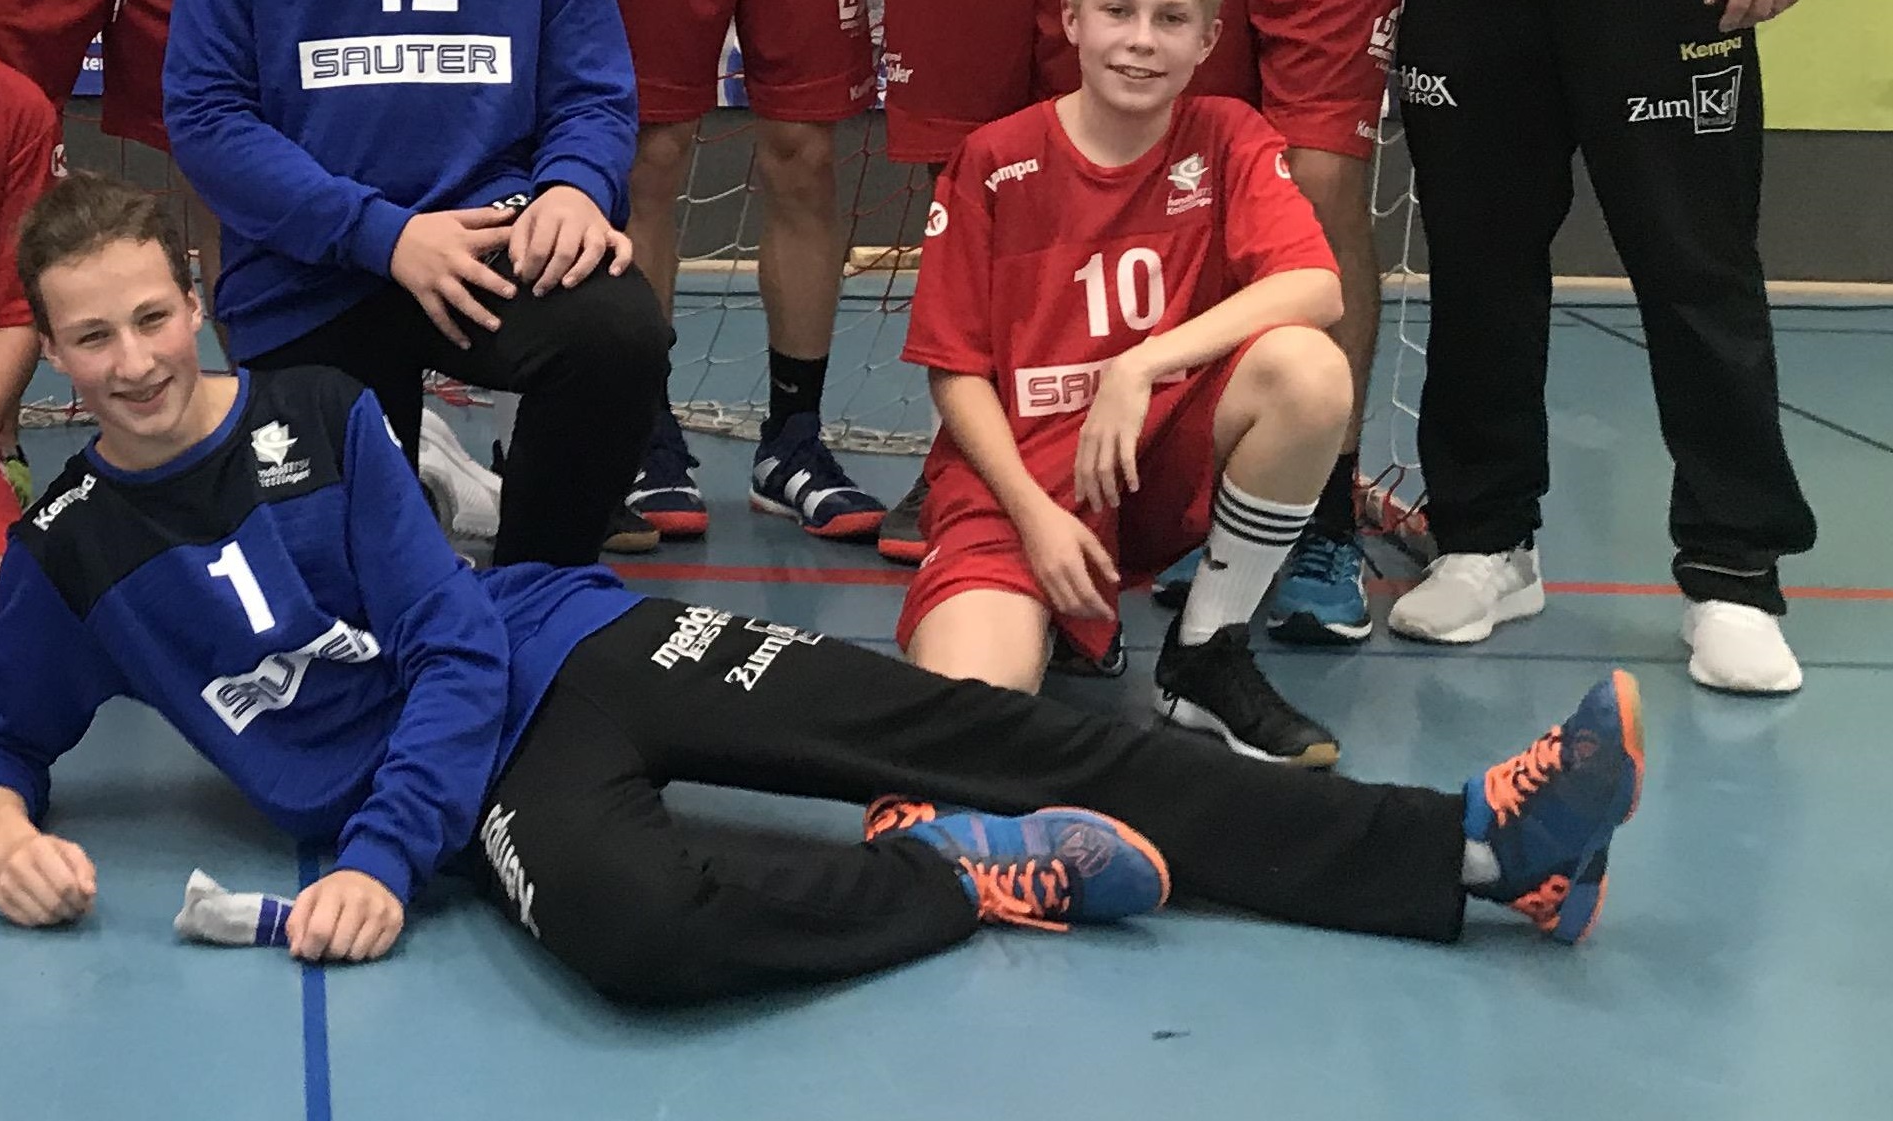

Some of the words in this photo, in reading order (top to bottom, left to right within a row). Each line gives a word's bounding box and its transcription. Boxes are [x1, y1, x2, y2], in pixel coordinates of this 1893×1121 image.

[310, 42, 498, 80] SAUTER
[1680, 36, 1743, 61] Kempa
[1074, 247, 1166, 338] 10
[32, 473, 98, 532] Kempa
[207, 540, 276, 635] 1
